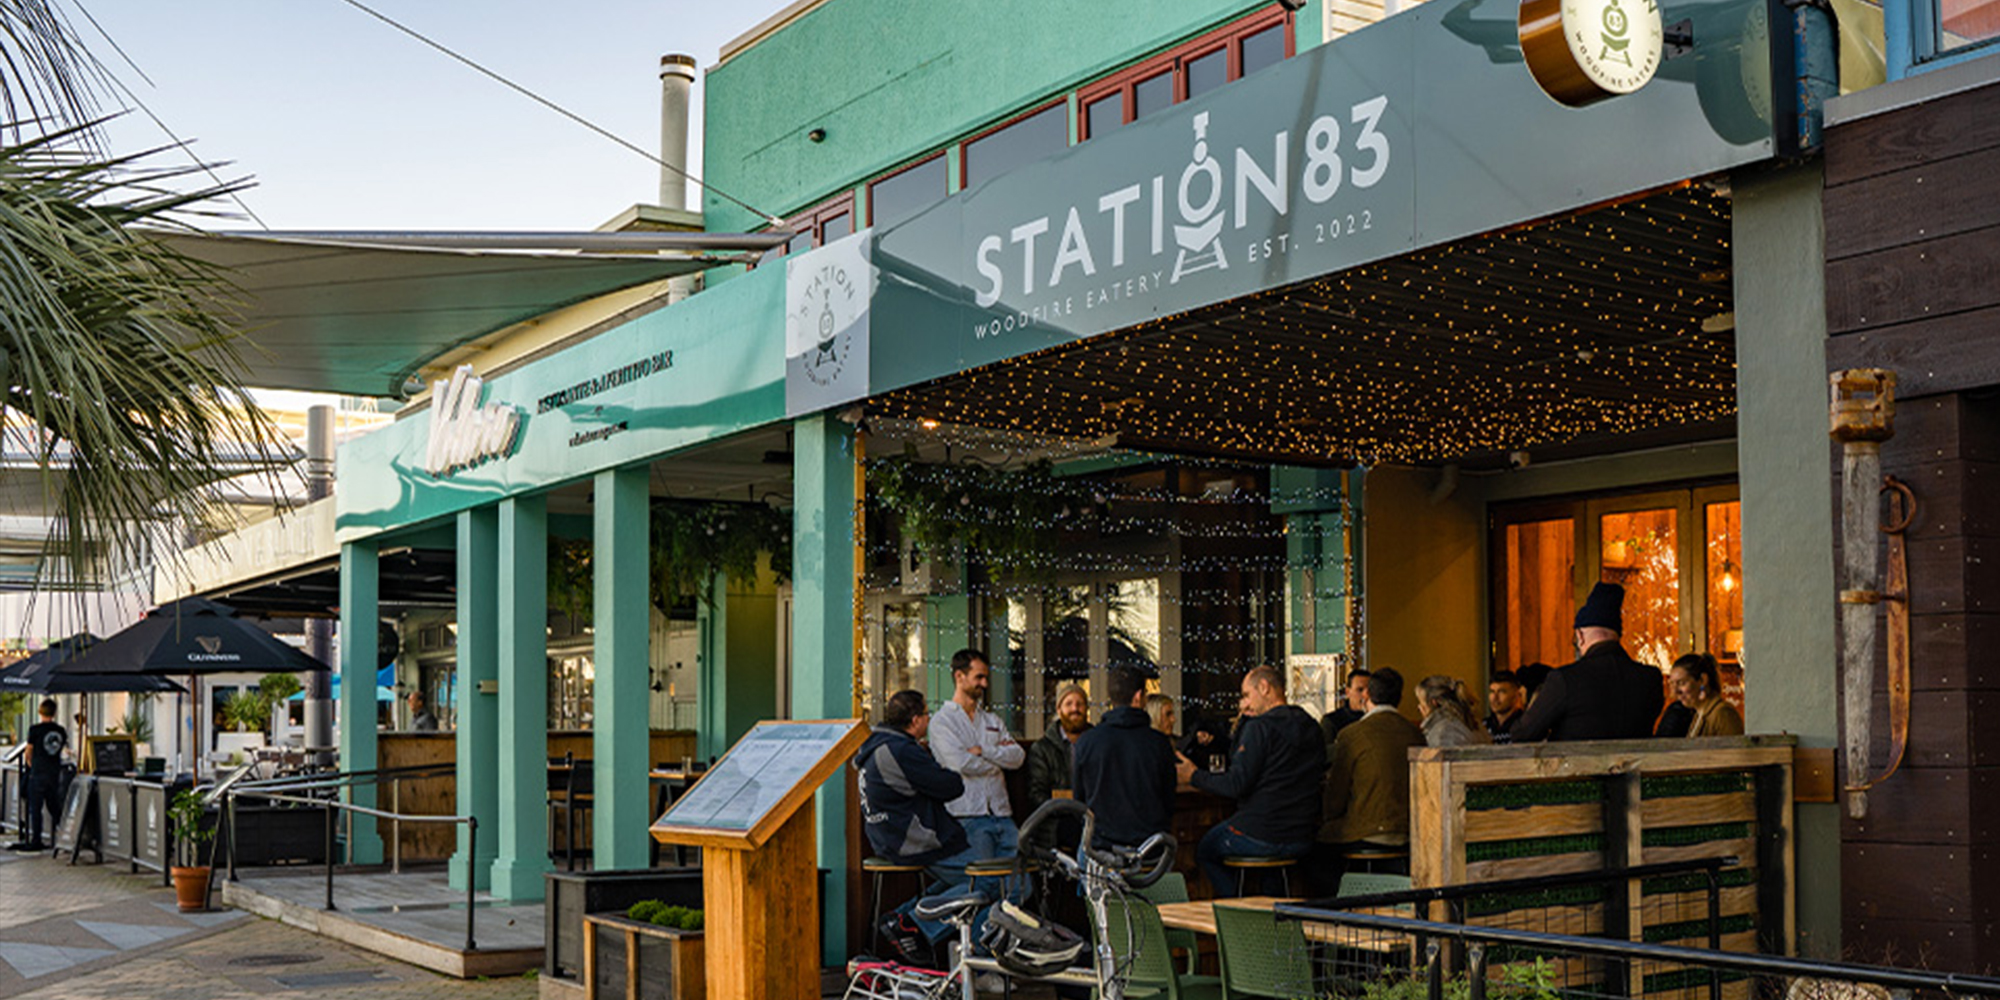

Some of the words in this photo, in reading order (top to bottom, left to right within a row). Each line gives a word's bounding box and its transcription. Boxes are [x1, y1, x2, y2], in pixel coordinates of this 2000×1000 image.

[1248, 233, 1299, 263] EST.
[1315, 209, 1372, 243] 2022
[800, 265, 856, 317] STATION
[974, 297, 1072, 339] WOODFIRE
[1086, 271, 1163, 309] EATERY
